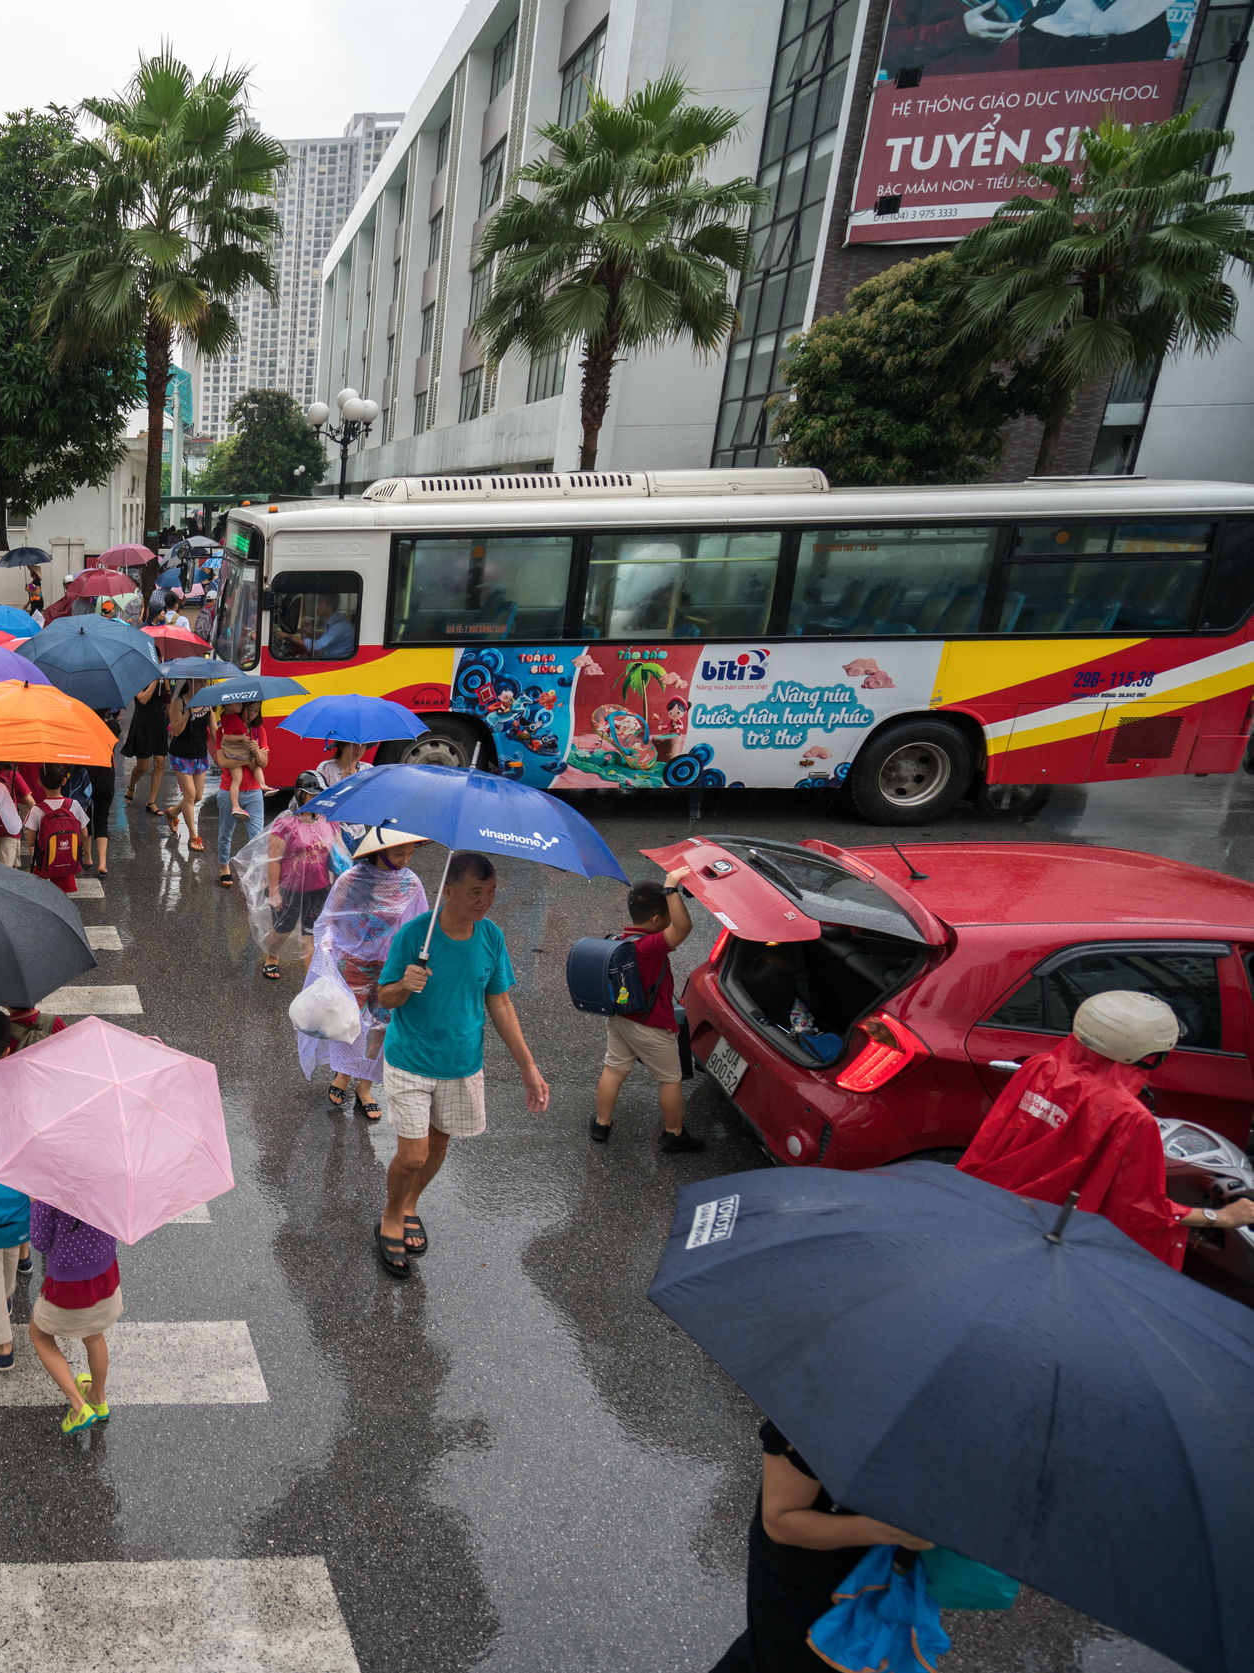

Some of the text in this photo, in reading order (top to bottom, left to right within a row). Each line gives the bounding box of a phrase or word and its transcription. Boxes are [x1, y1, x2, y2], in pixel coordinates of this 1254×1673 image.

[892, 85, 1159, 117] HỆ THỐNG GIÁO DỤC VINSCHOOL
[886, 114, 1031, 172] TUYỂN
[942, 179, 975, 192] NON
[910, 210, 917, 219] 3
[919, 209, 935, 218] 975
[938, 208, 958, 217] 3333
[1110, 671, 1155, 688] 115.38
[771, 685, 852, 709] Nâng niu
[696, 707, 870, 730] bước chân hạnh phúc
[747, 729, 803, 746] trẻ thơ
[478, 828, 541, 847] vinaphone
[721, 1043, 741, 1070] 30A
[710, 1197, 735, 1241] TOYOTA
